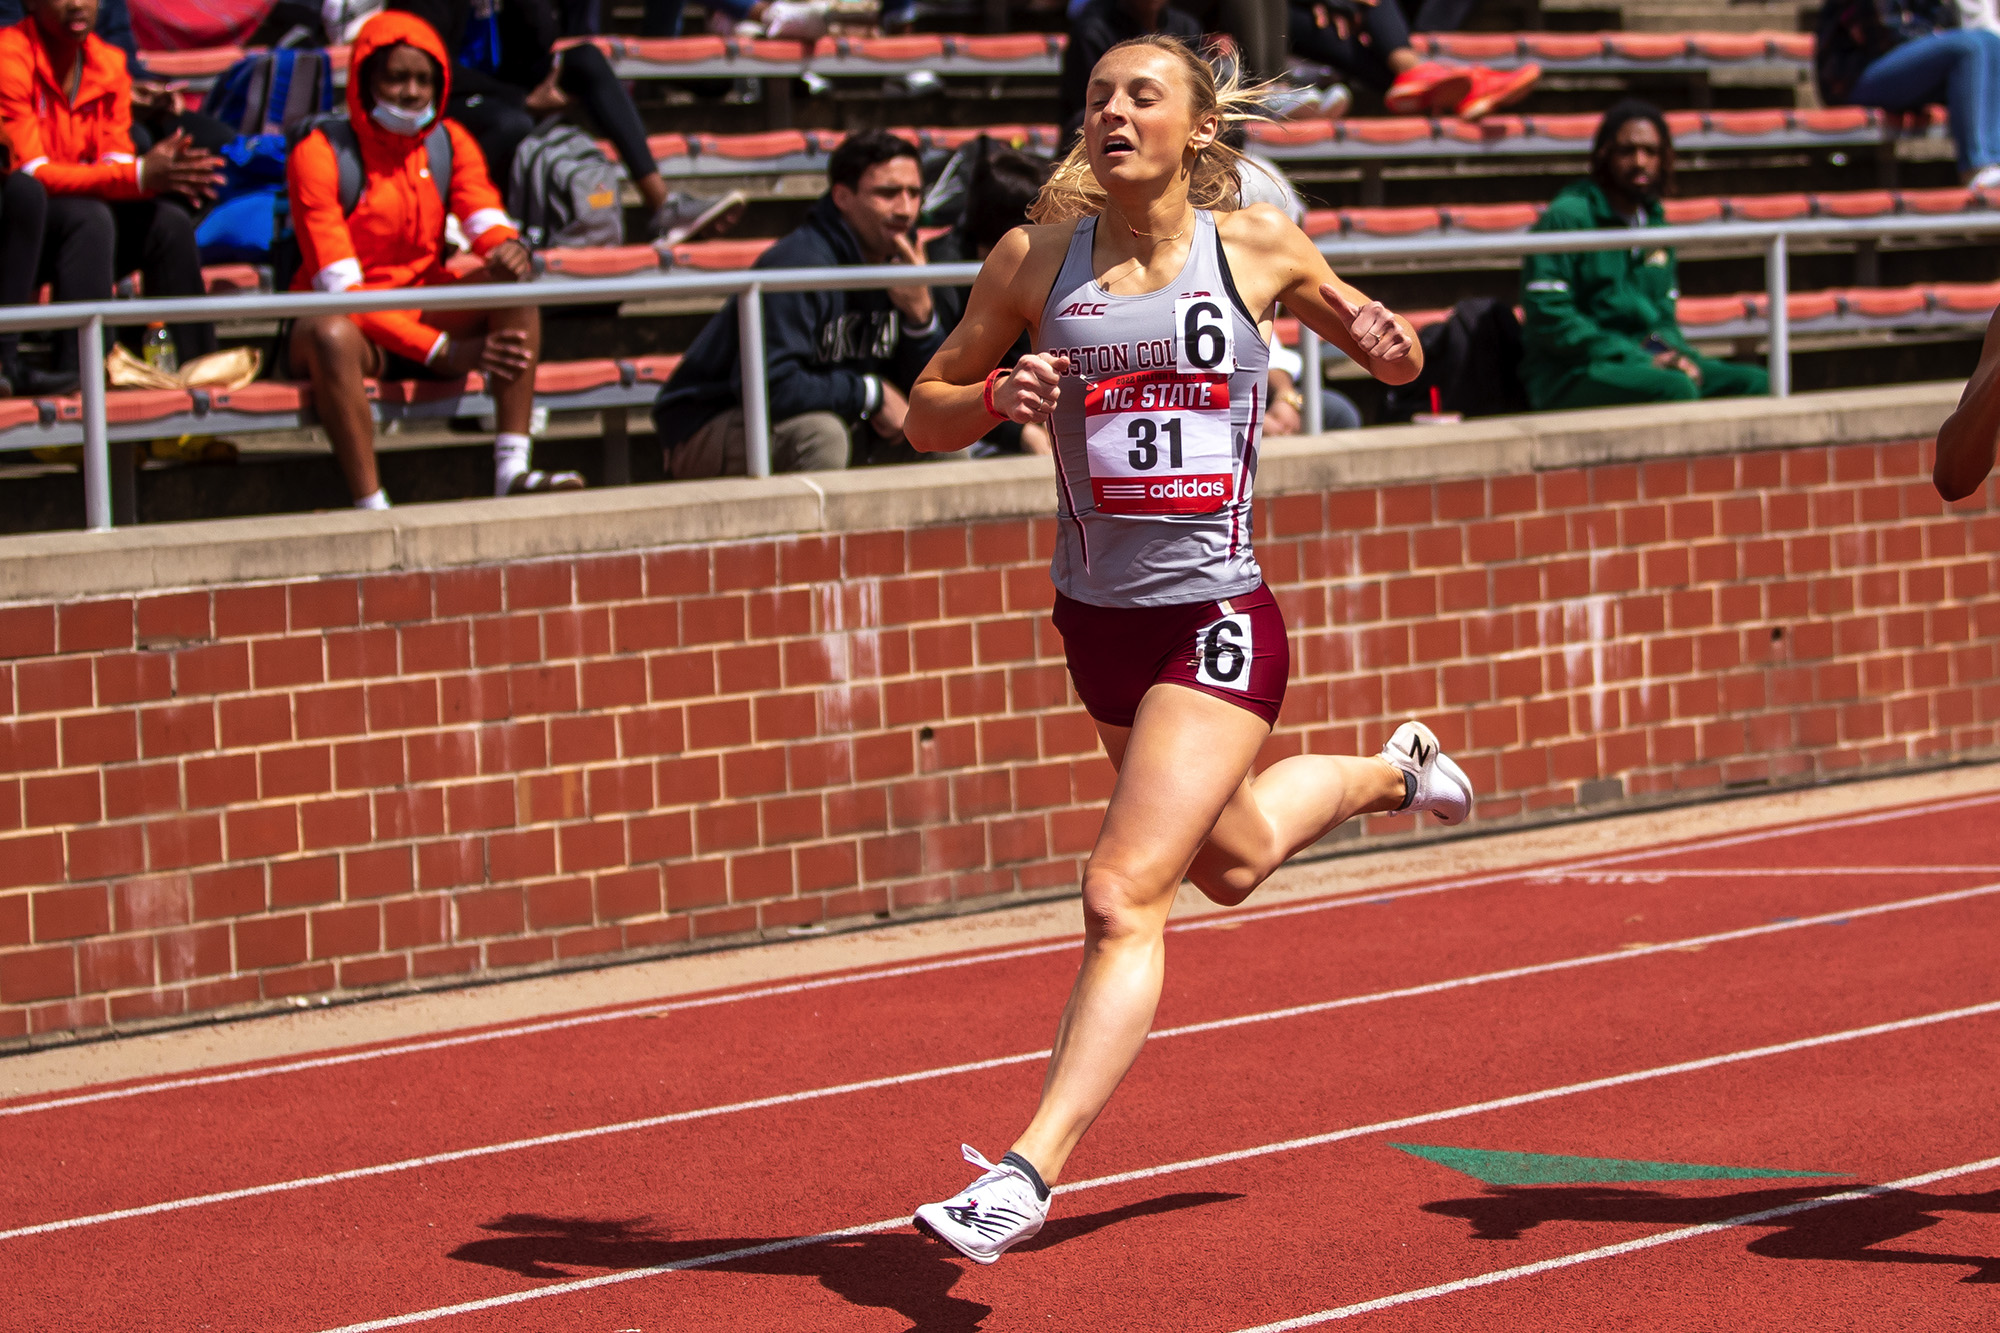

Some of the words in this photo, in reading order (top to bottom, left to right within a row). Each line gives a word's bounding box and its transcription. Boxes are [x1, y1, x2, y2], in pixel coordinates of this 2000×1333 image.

[1057, 302, 1109, 317] ACC
[1184, 301, 1226, 369] 6
[1116, 375, 1136, 385] 2022
[1101, 387, 1135, 412] NC
[1140, 382, 1213, 409] STATE
[1127, 418, 1183, 471] 31
[1149, 478, 1225, 499] adidas
[1204, 620, 1245, 683] 6
